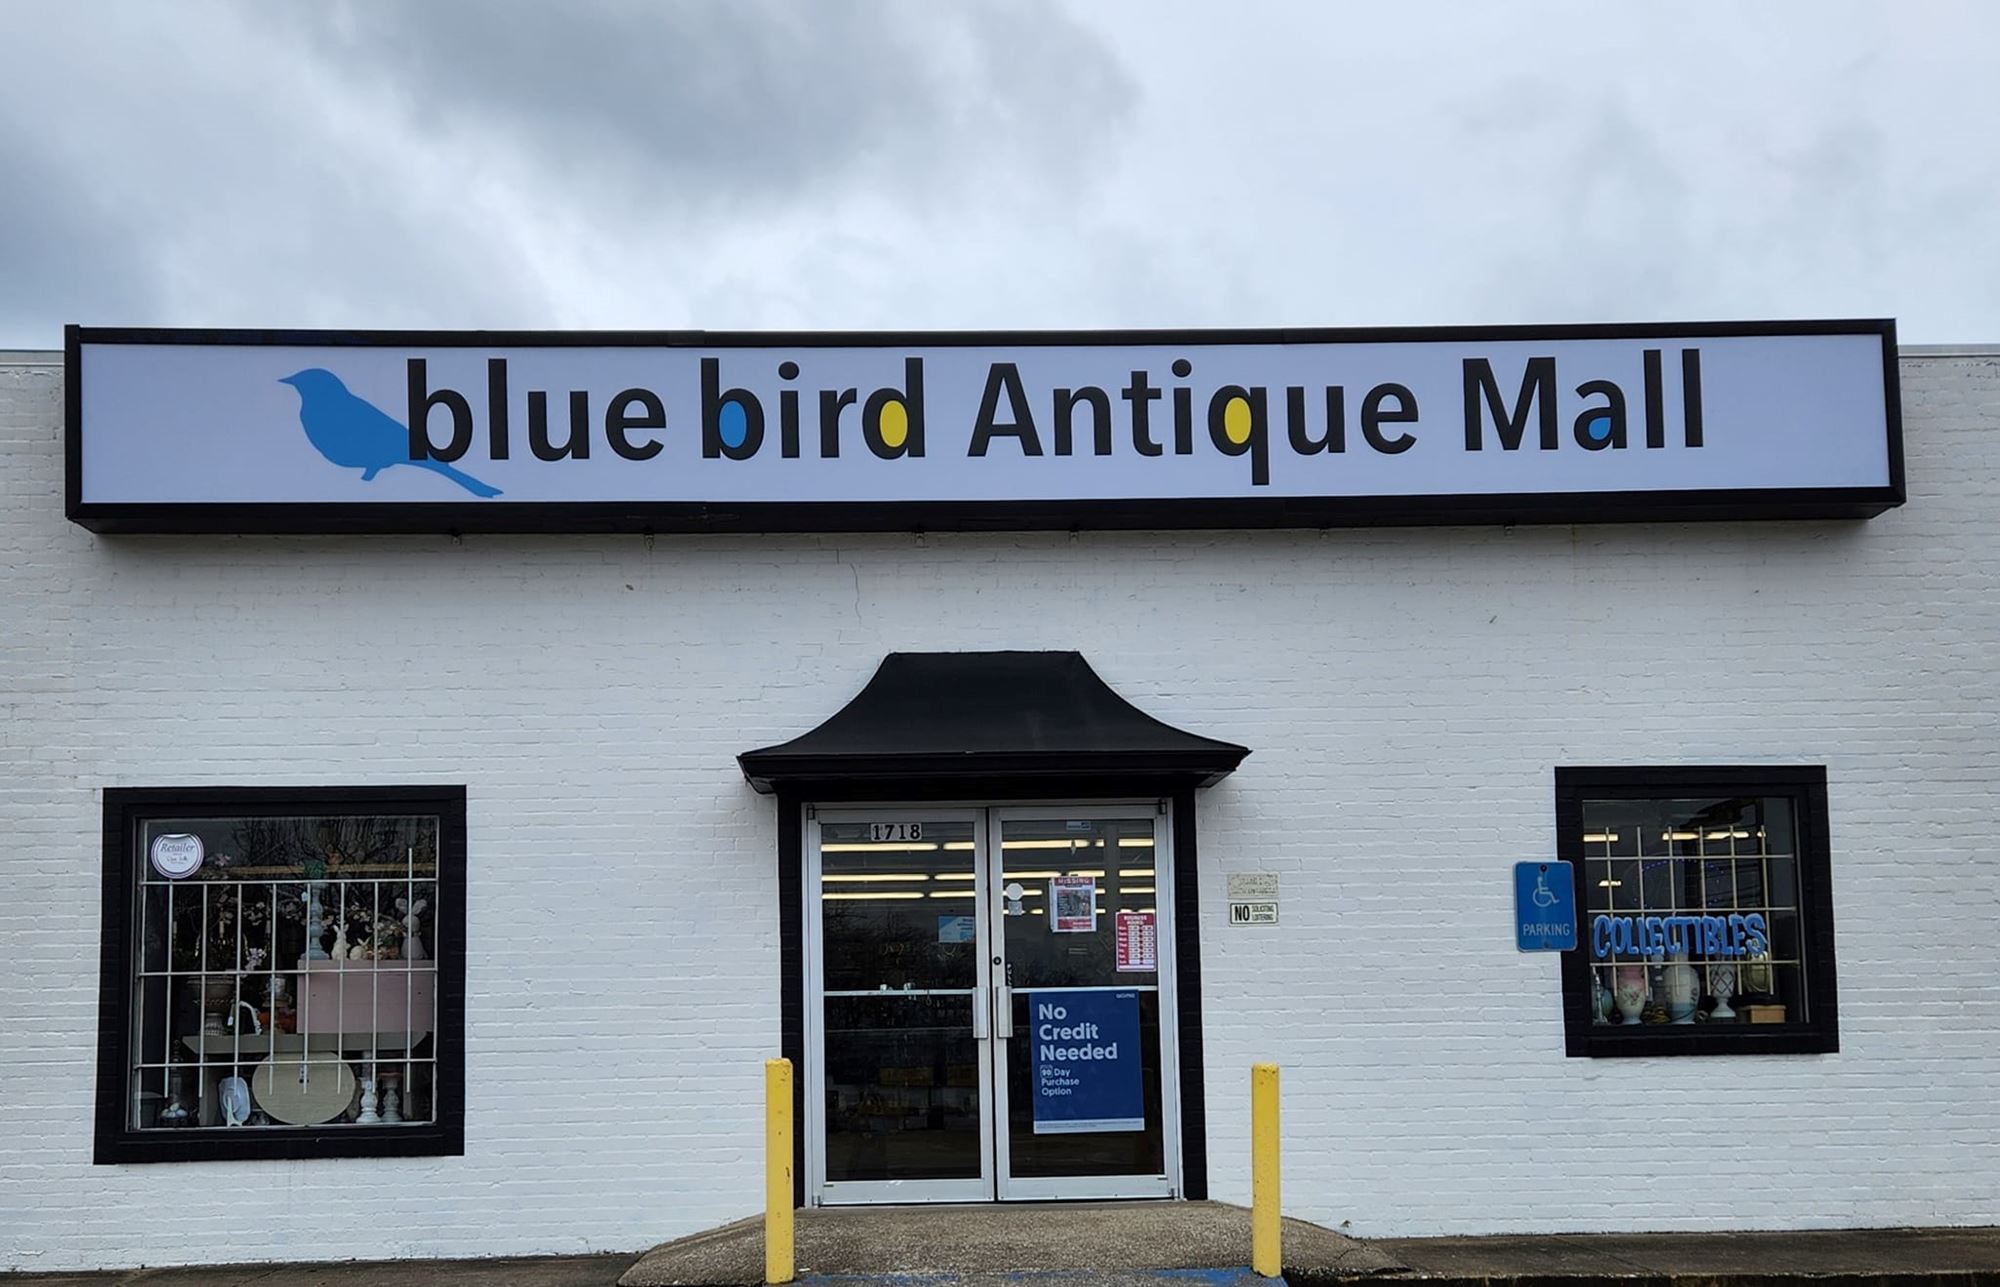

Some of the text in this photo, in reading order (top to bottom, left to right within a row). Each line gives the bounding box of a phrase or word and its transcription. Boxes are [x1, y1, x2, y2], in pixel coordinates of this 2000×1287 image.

[407, 348, 1704, 486] blue bird Antique Mall
[873, 824, 921, 840] 1718
[160, 843, 195, 852] Retailer
[1234, 905, 1250, 921] NO
[1522, 922, 1570, 937] PARKING
[1593, 914, 1767, 957] COLLECTIBLES
[1039, 1003, 1067, 1020] No
[1039, 1022, 1099, 1040] Credit
[1040, 1043, 1118, 1061] Needed
[1054, 1068, 1070, 1077] Day
[1041, 1077, 1080, 1086] Purchase
[1041, 1087, 1072, 1097] Option
